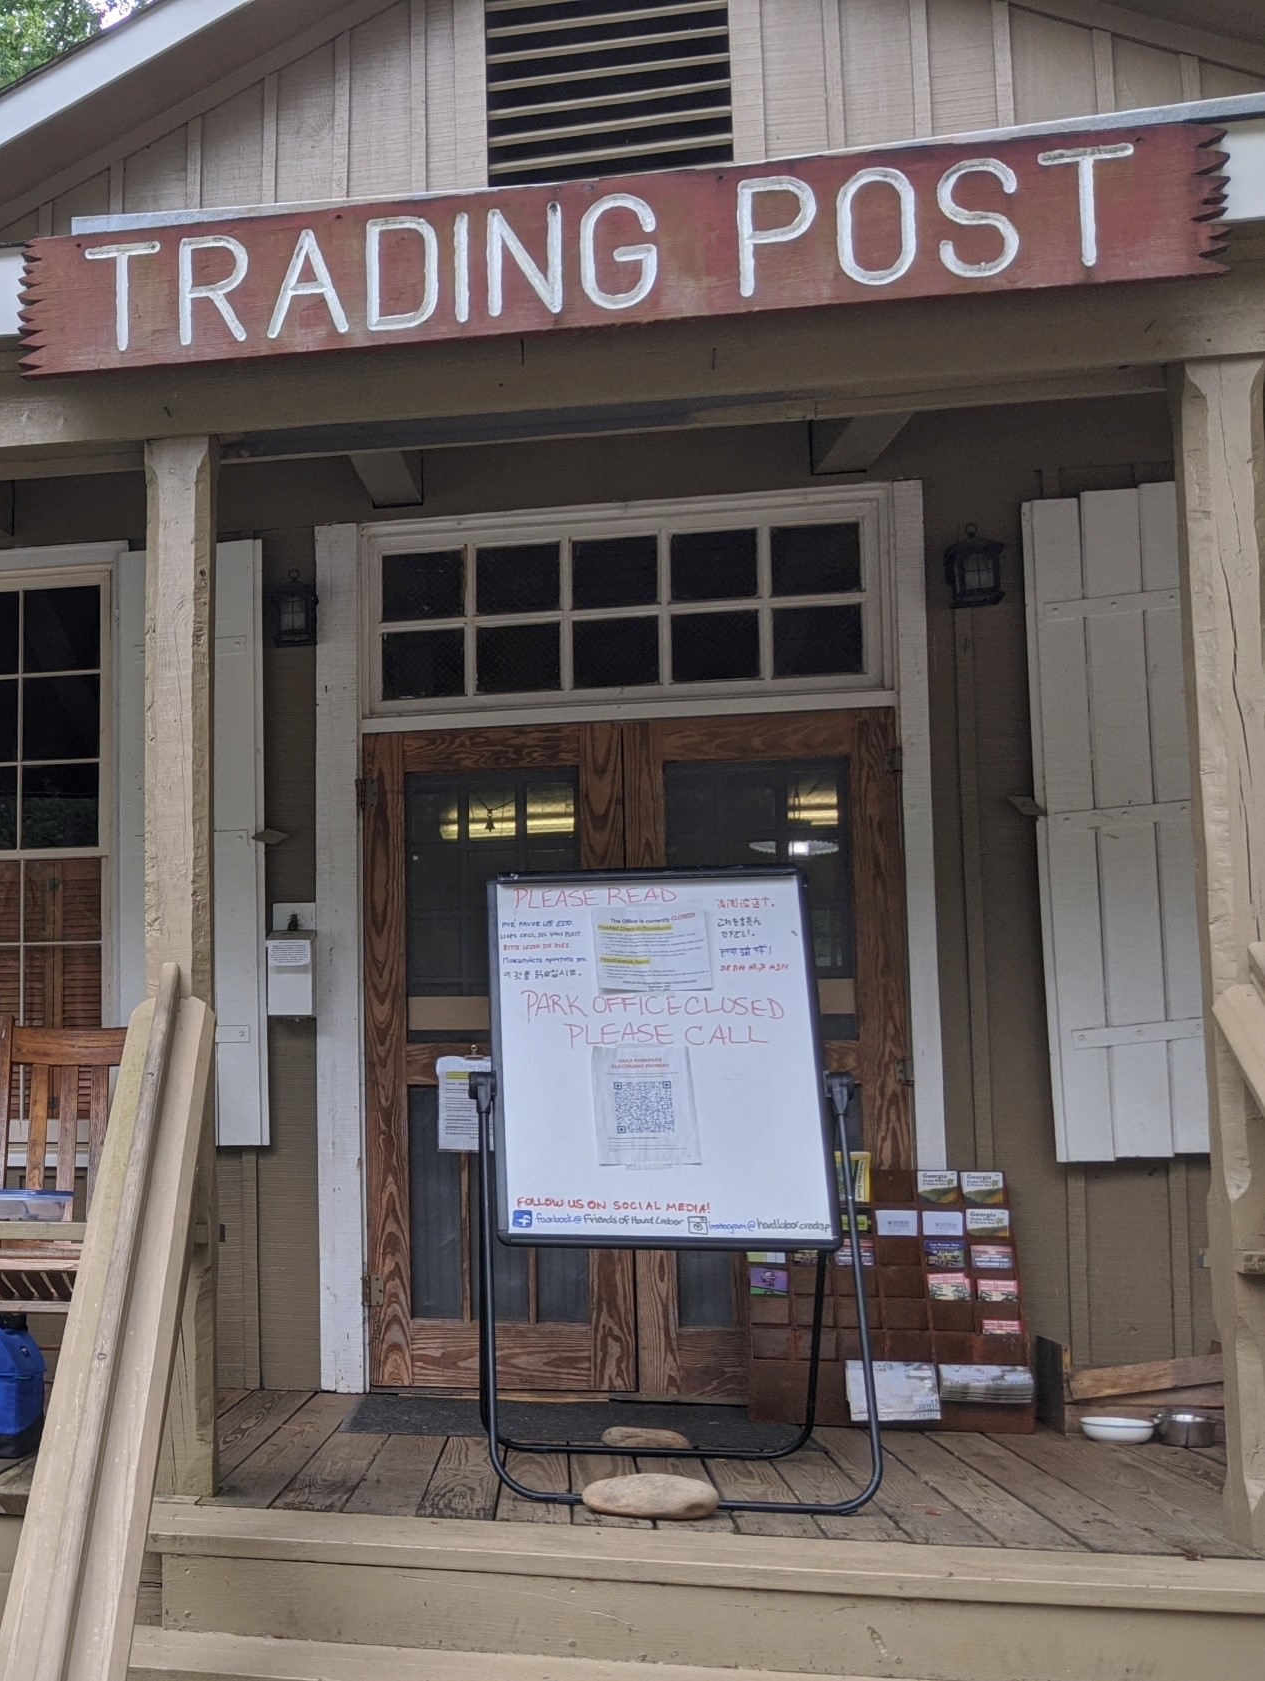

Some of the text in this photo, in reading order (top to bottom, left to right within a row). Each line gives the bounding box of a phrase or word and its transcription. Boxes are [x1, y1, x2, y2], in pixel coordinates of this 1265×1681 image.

[85, 142, 1135, 352] TRADING POST
[513, 886, 677, 909] PLEASE READ
[520, 990, 784, 1023] PARK OFFICE CLOSED
[563, 1022, 768, 1049] PLEASE CALL
[517, 1197, 710, 1214] FOLLOW US ON SOCIAL MEDIA!
[584, 1214, 617, 1224] Friends
[619, 1214, 629, 1225] of
[631, 1216, 654, 1225] Hard
[655, 1216, 684, 1226] Labor
